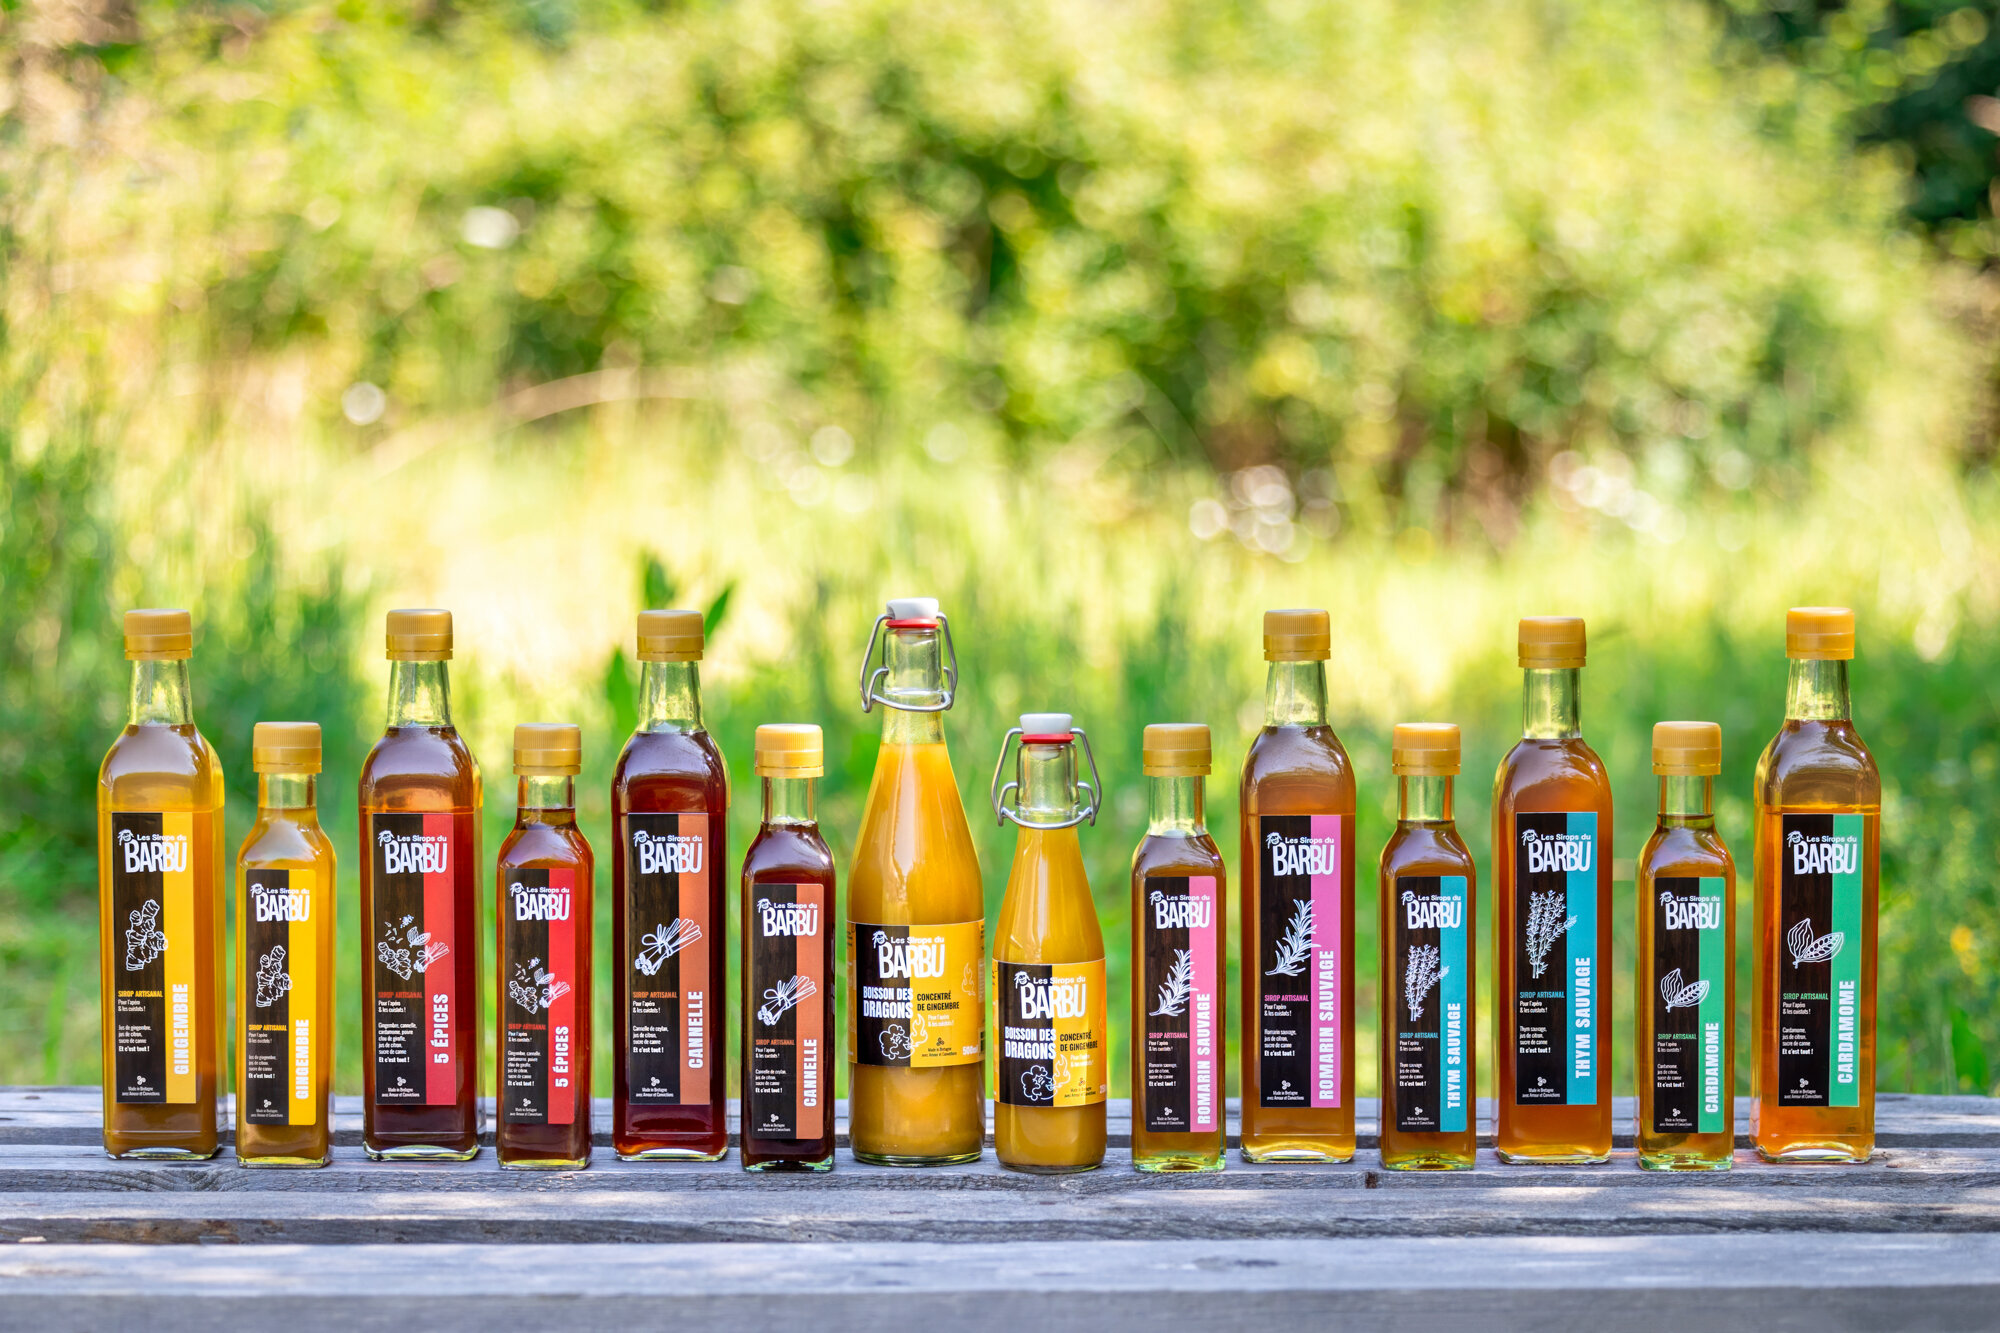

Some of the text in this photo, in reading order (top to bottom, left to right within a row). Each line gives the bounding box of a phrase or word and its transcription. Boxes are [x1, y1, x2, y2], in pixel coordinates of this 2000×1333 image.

[125, 839, 187, 872] BARBU
[385, 840, 447, 873] BARBU
[640, 840, 702, 874] BARBU
[1273, 842, 1334, 876] BARBU
[1528, 839, 1591, 872] BARBU
[1794, 841, 1857, 874] BARBU
[256, 892, 310, 921] BARBU
[516, 891, 570, 920] BARBU
[763, 907, 817, 936] BARBU
[1156, 900, 1210, 929] BARBU
[1407, 900, 1461, 929] BARBU
[1666, 900, 1720, 930] BARBU
[878, 942, 945, 978] BARBU
[863, 986, 913, 1000] BOISSON DES
[863, 1000, 913, 1019] DRAGONS
[917, 990, 951, 1001] CONCENTRÉ
[927, 1002, 959, 1010] GINGEMBRE
[1020, 983, 1086, 1019] BARBU
[173, 984, 189, 1074] GINGEMBRE
[431, 994, 449, 1063] 5 ÉPICES
[688, 992, 703, 1068] CANNELLE
[1005, 1026, 1056, 1041] BOISSON DES
[1319, 951, 1334, 1100] ROMARIN SAUVAGE
[1576, 958, 1590, 1078] THYM SAUVAGE
[1838, 981, 1854, 1083] CARDAMOME
[1005, 1041, 1056, 1059] DRAGONS
[1060, 1031, 1091, 1041] CONCENTRÉ
[1070, 1040, 1098, 1051] GINGEMBRE
[296, 1020, 308, 1099] GINGEMBRE
[553, 1026, 568, 1087] 5 ÉPICES
[1197, 994, 1210, 1124] ROMARIN SAUVAGE
[1448, 1003, 1460, 1108] THYM SAUVAGE
[1705, 1023, 1719, 1113] CARDAMOME
[804, 1039, 816, 1107] CANNELLE
